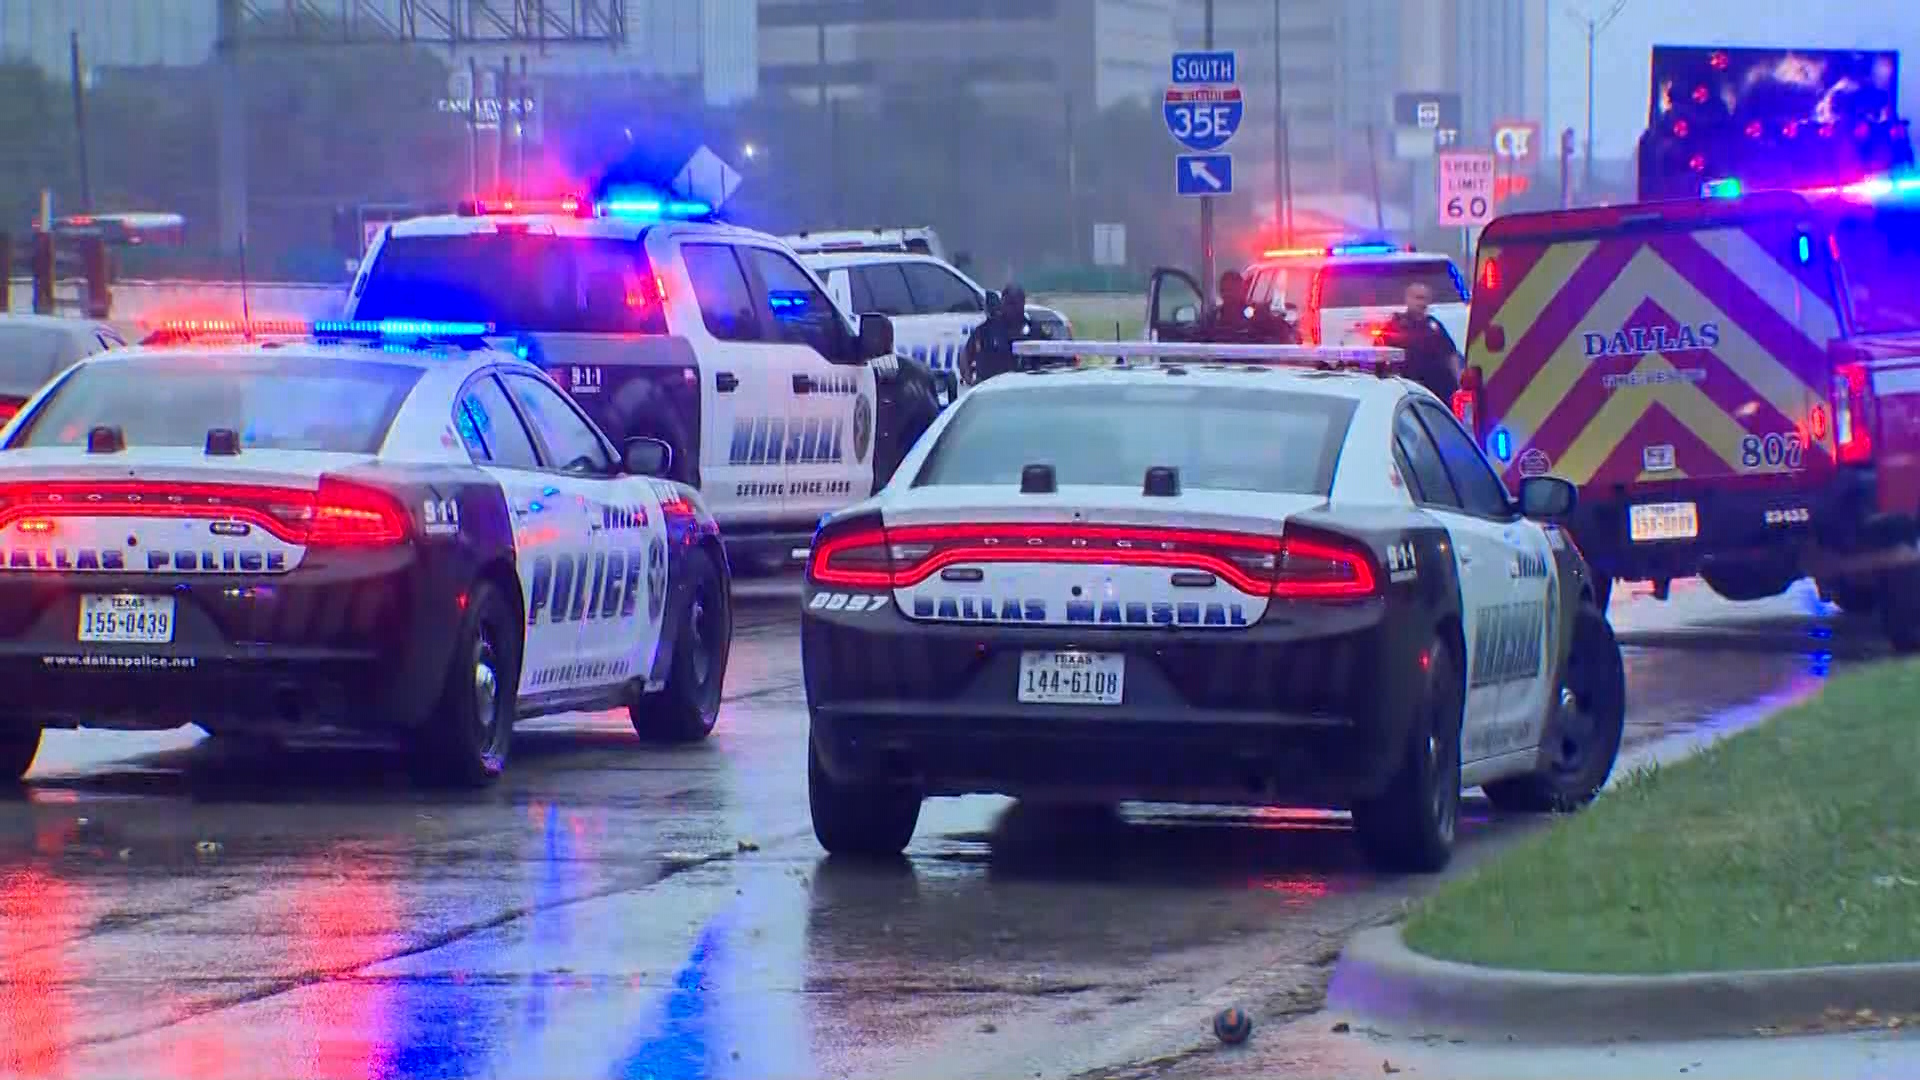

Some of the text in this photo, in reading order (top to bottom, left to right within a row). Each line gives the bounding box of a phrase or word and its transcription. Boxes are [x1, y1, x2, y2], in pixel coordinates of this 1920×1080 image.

[1176, 58, 1232, 80] SOUTH
[1174, 107, 1232, 138] 35E
[1448, 178, 1487, 191] LIMIT
[1447, 196, 1487, 218] 60
[1583, 320, 1720, 358] DALLAS
[1741, 431, 1804, 468] 807
[147, 550, 287, 570] POLICE
[913, 597, 1247, 626] DALLAS MARSHAL
